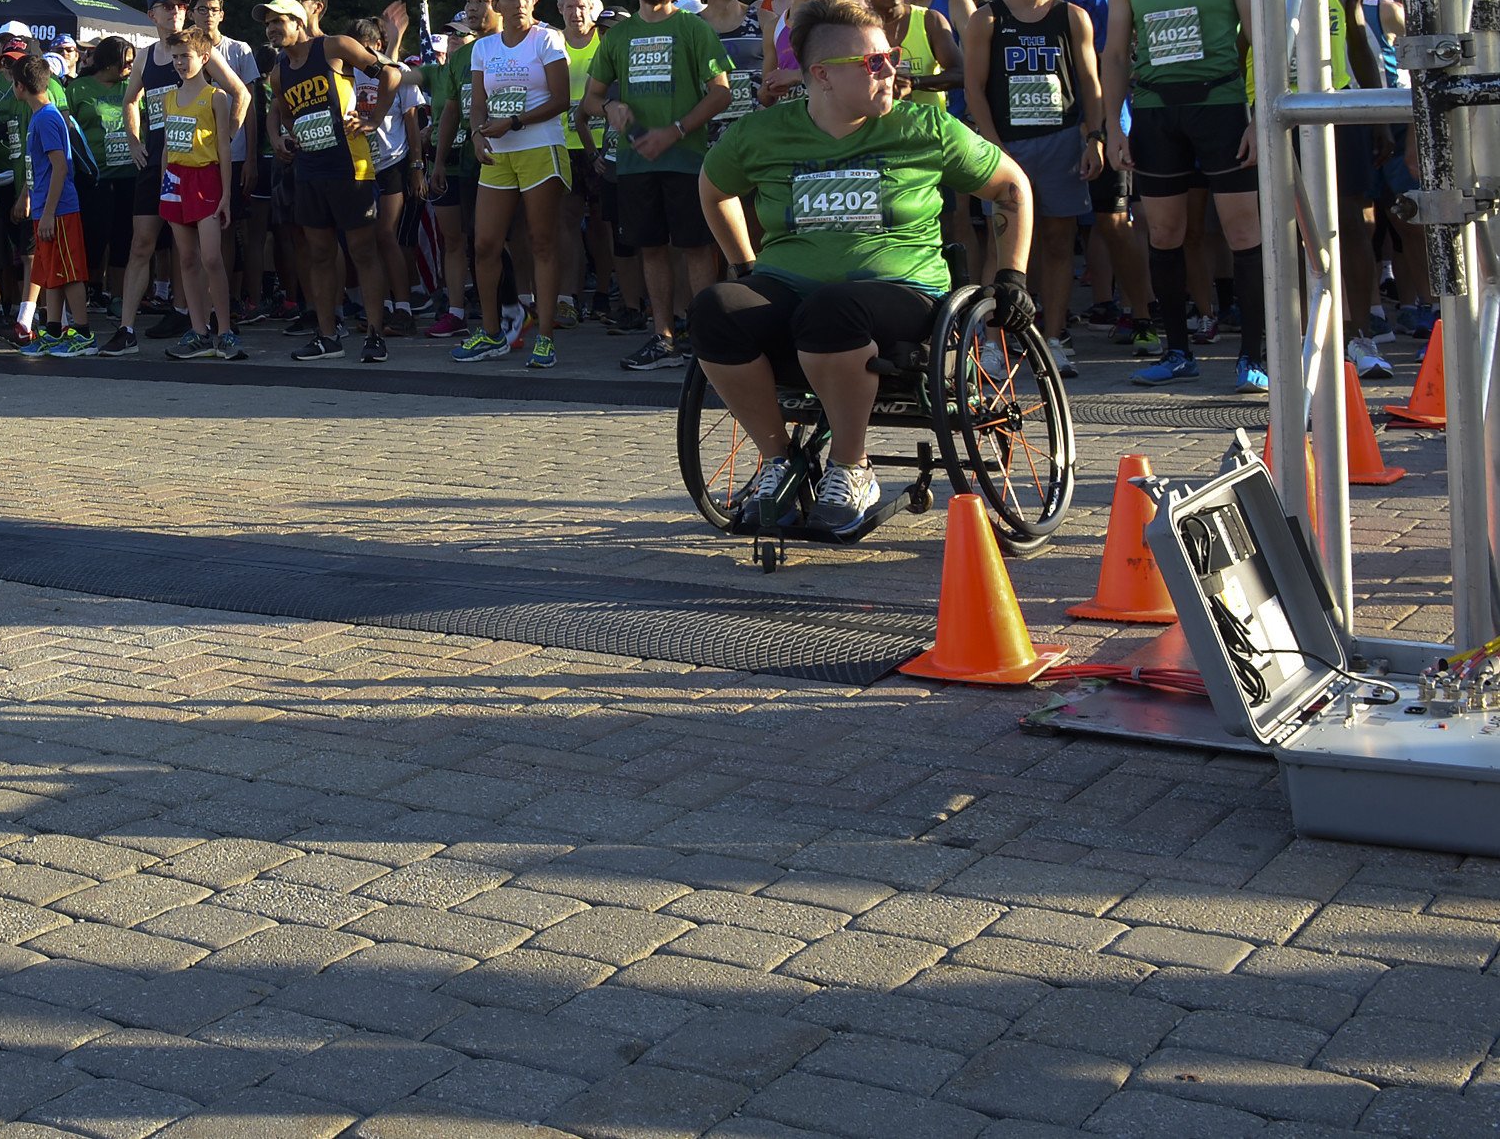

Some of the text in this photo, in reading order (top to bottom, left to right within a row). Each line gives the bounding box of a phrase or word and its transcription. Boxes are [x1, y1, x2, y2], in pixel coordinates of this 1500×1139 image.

[1018, 36, 1046, 46] THE
[1149, 25, 1199, 44] 14022
[630, 52, 669, 65] 12591
[1004, 46, 1062, 71] PIT
[284, 75, 330, 111] NYPD
[1011, 92, 1061, 105] 13656
[310, 95, 328, 106] CLUB
[487, 101, 524, 112] 14235
[166, 129, 193, 142] 4193
[297, 125, 333, 142] 13689
[798, 190, 878, 213] 14202
[872, 402, 909, 413] ND
